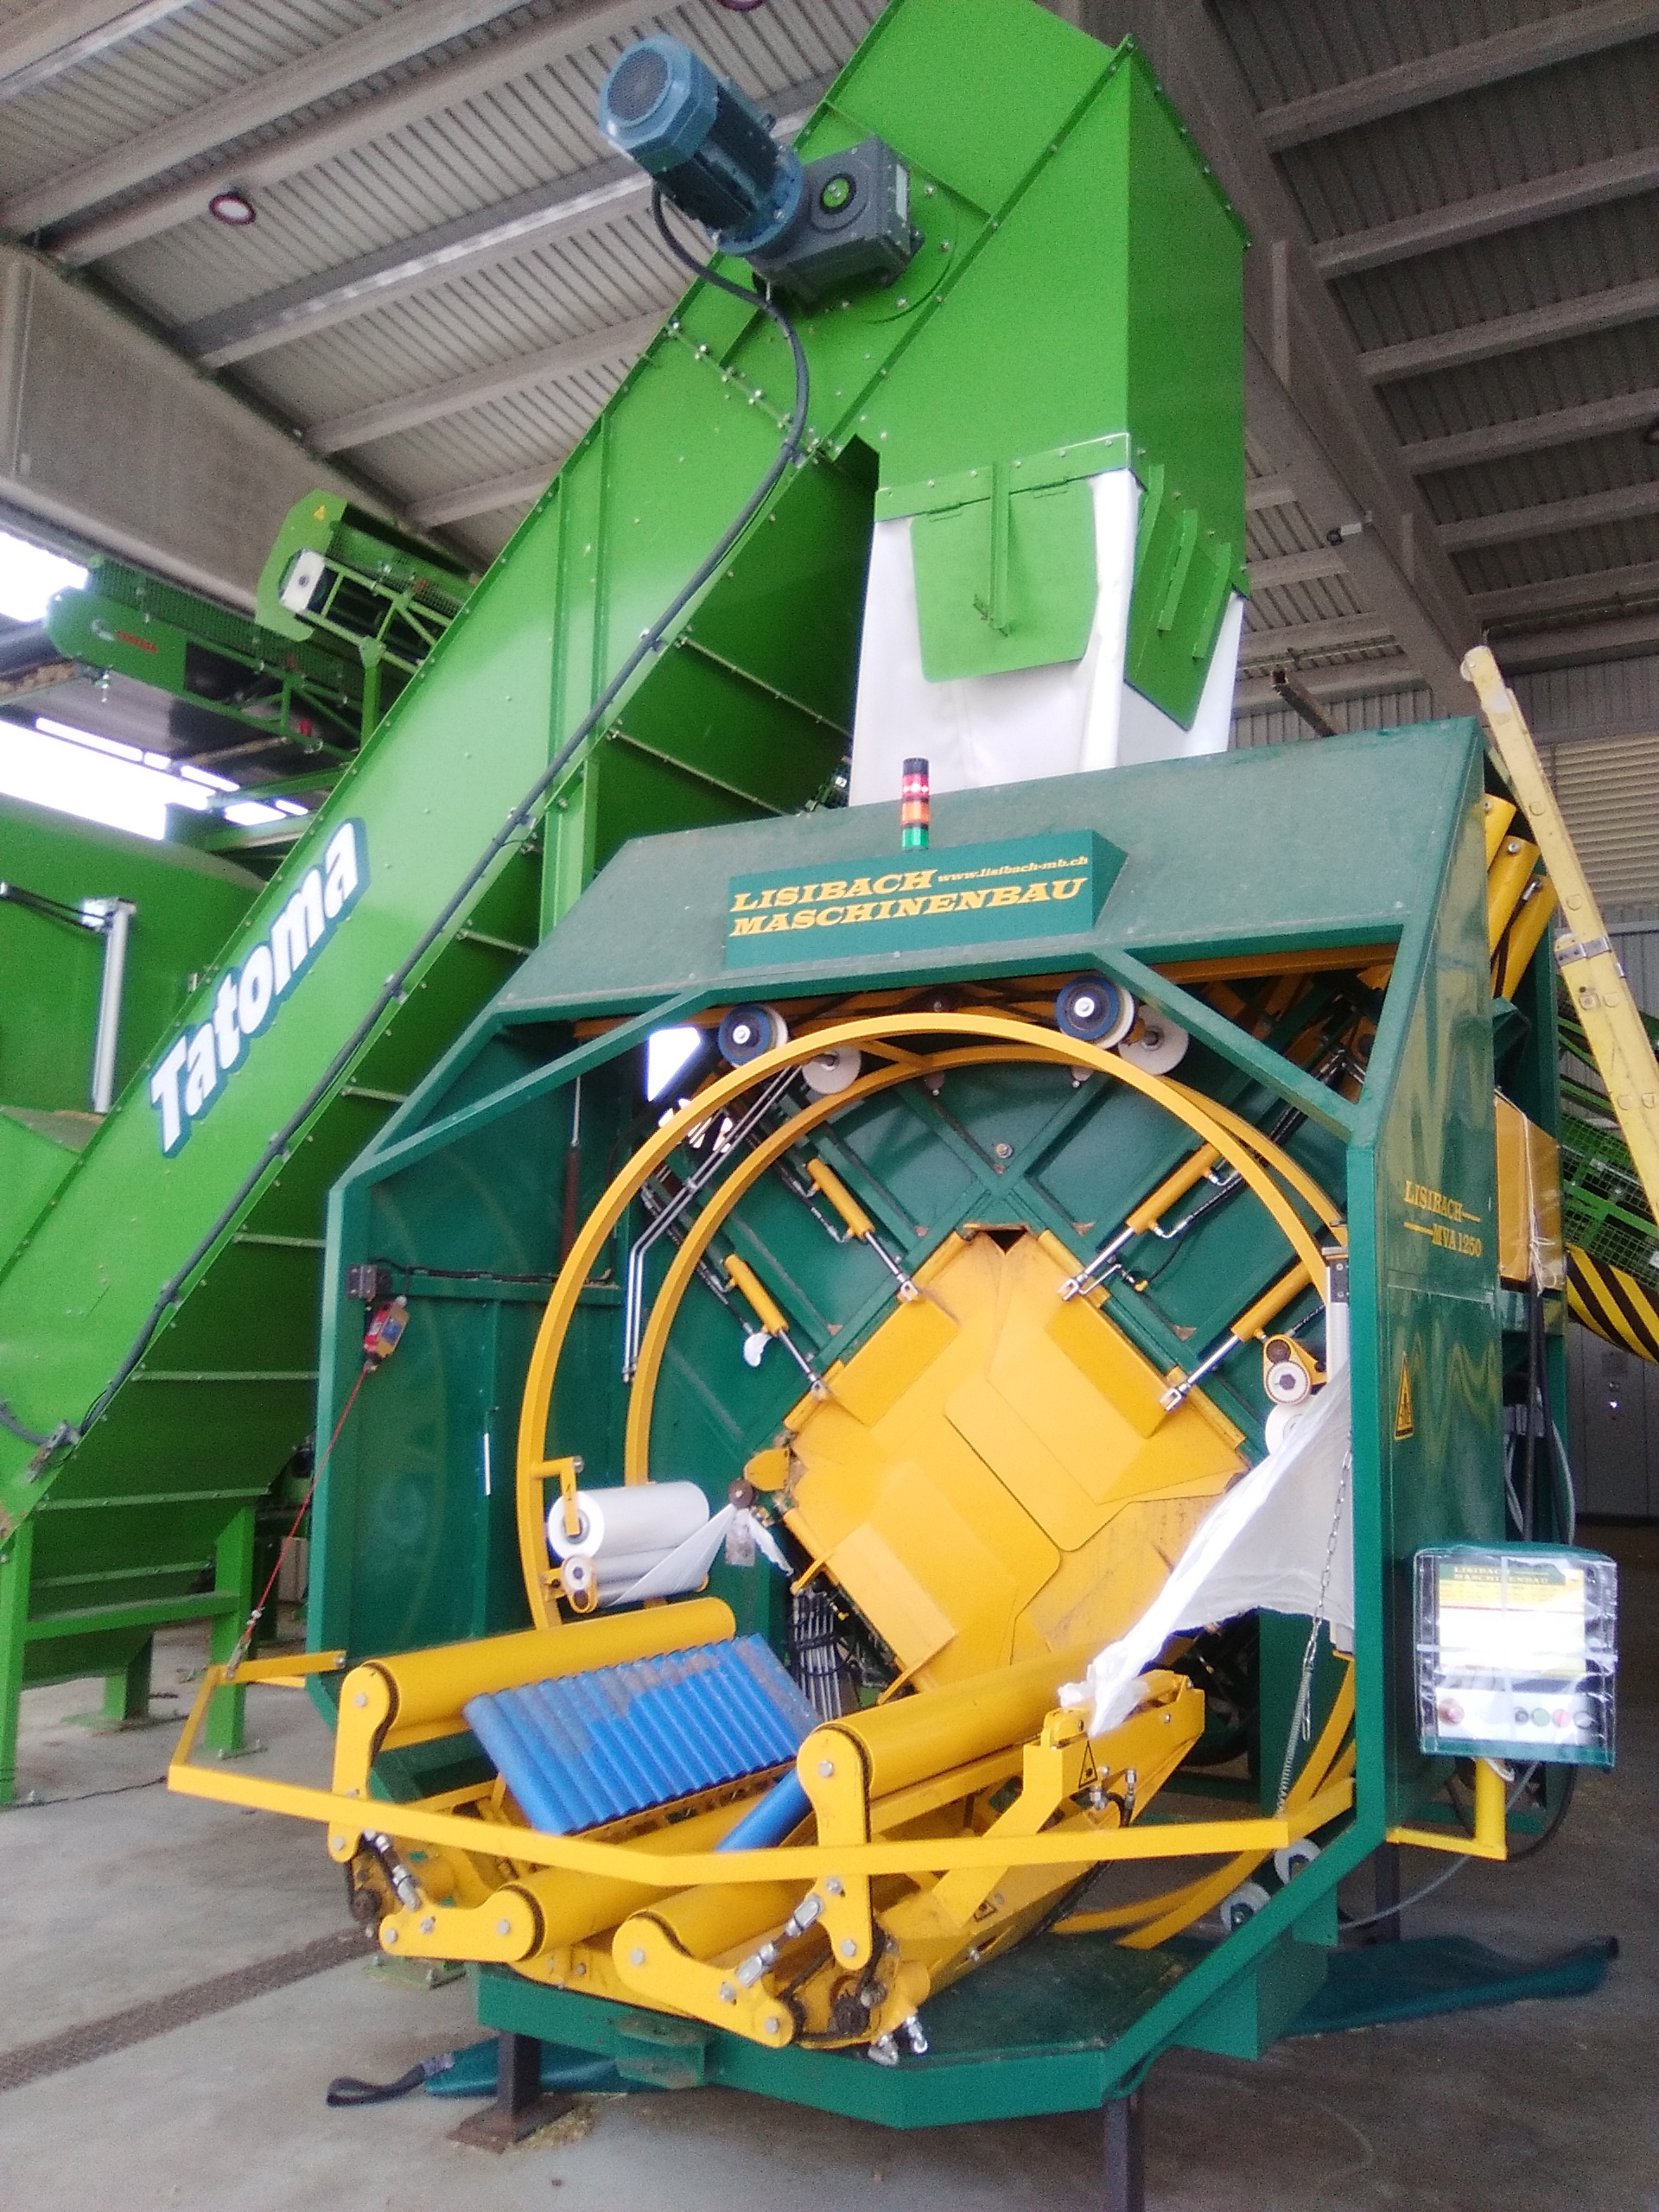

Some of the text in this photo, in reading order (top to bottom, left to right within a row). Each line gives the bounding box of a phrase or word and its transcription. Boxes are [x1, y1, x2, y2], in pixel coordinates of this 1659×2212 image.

[730, 869, 938, 912] LISIBACH
[938, 857, 1089, 882] www.lisibach-mb.ch
[729, 878, 1088, 937] MASCHINENBAU
[150, 823, 359, 1153] Tatoma
[1405, 1180, 1462, 1223] LISIBACH
